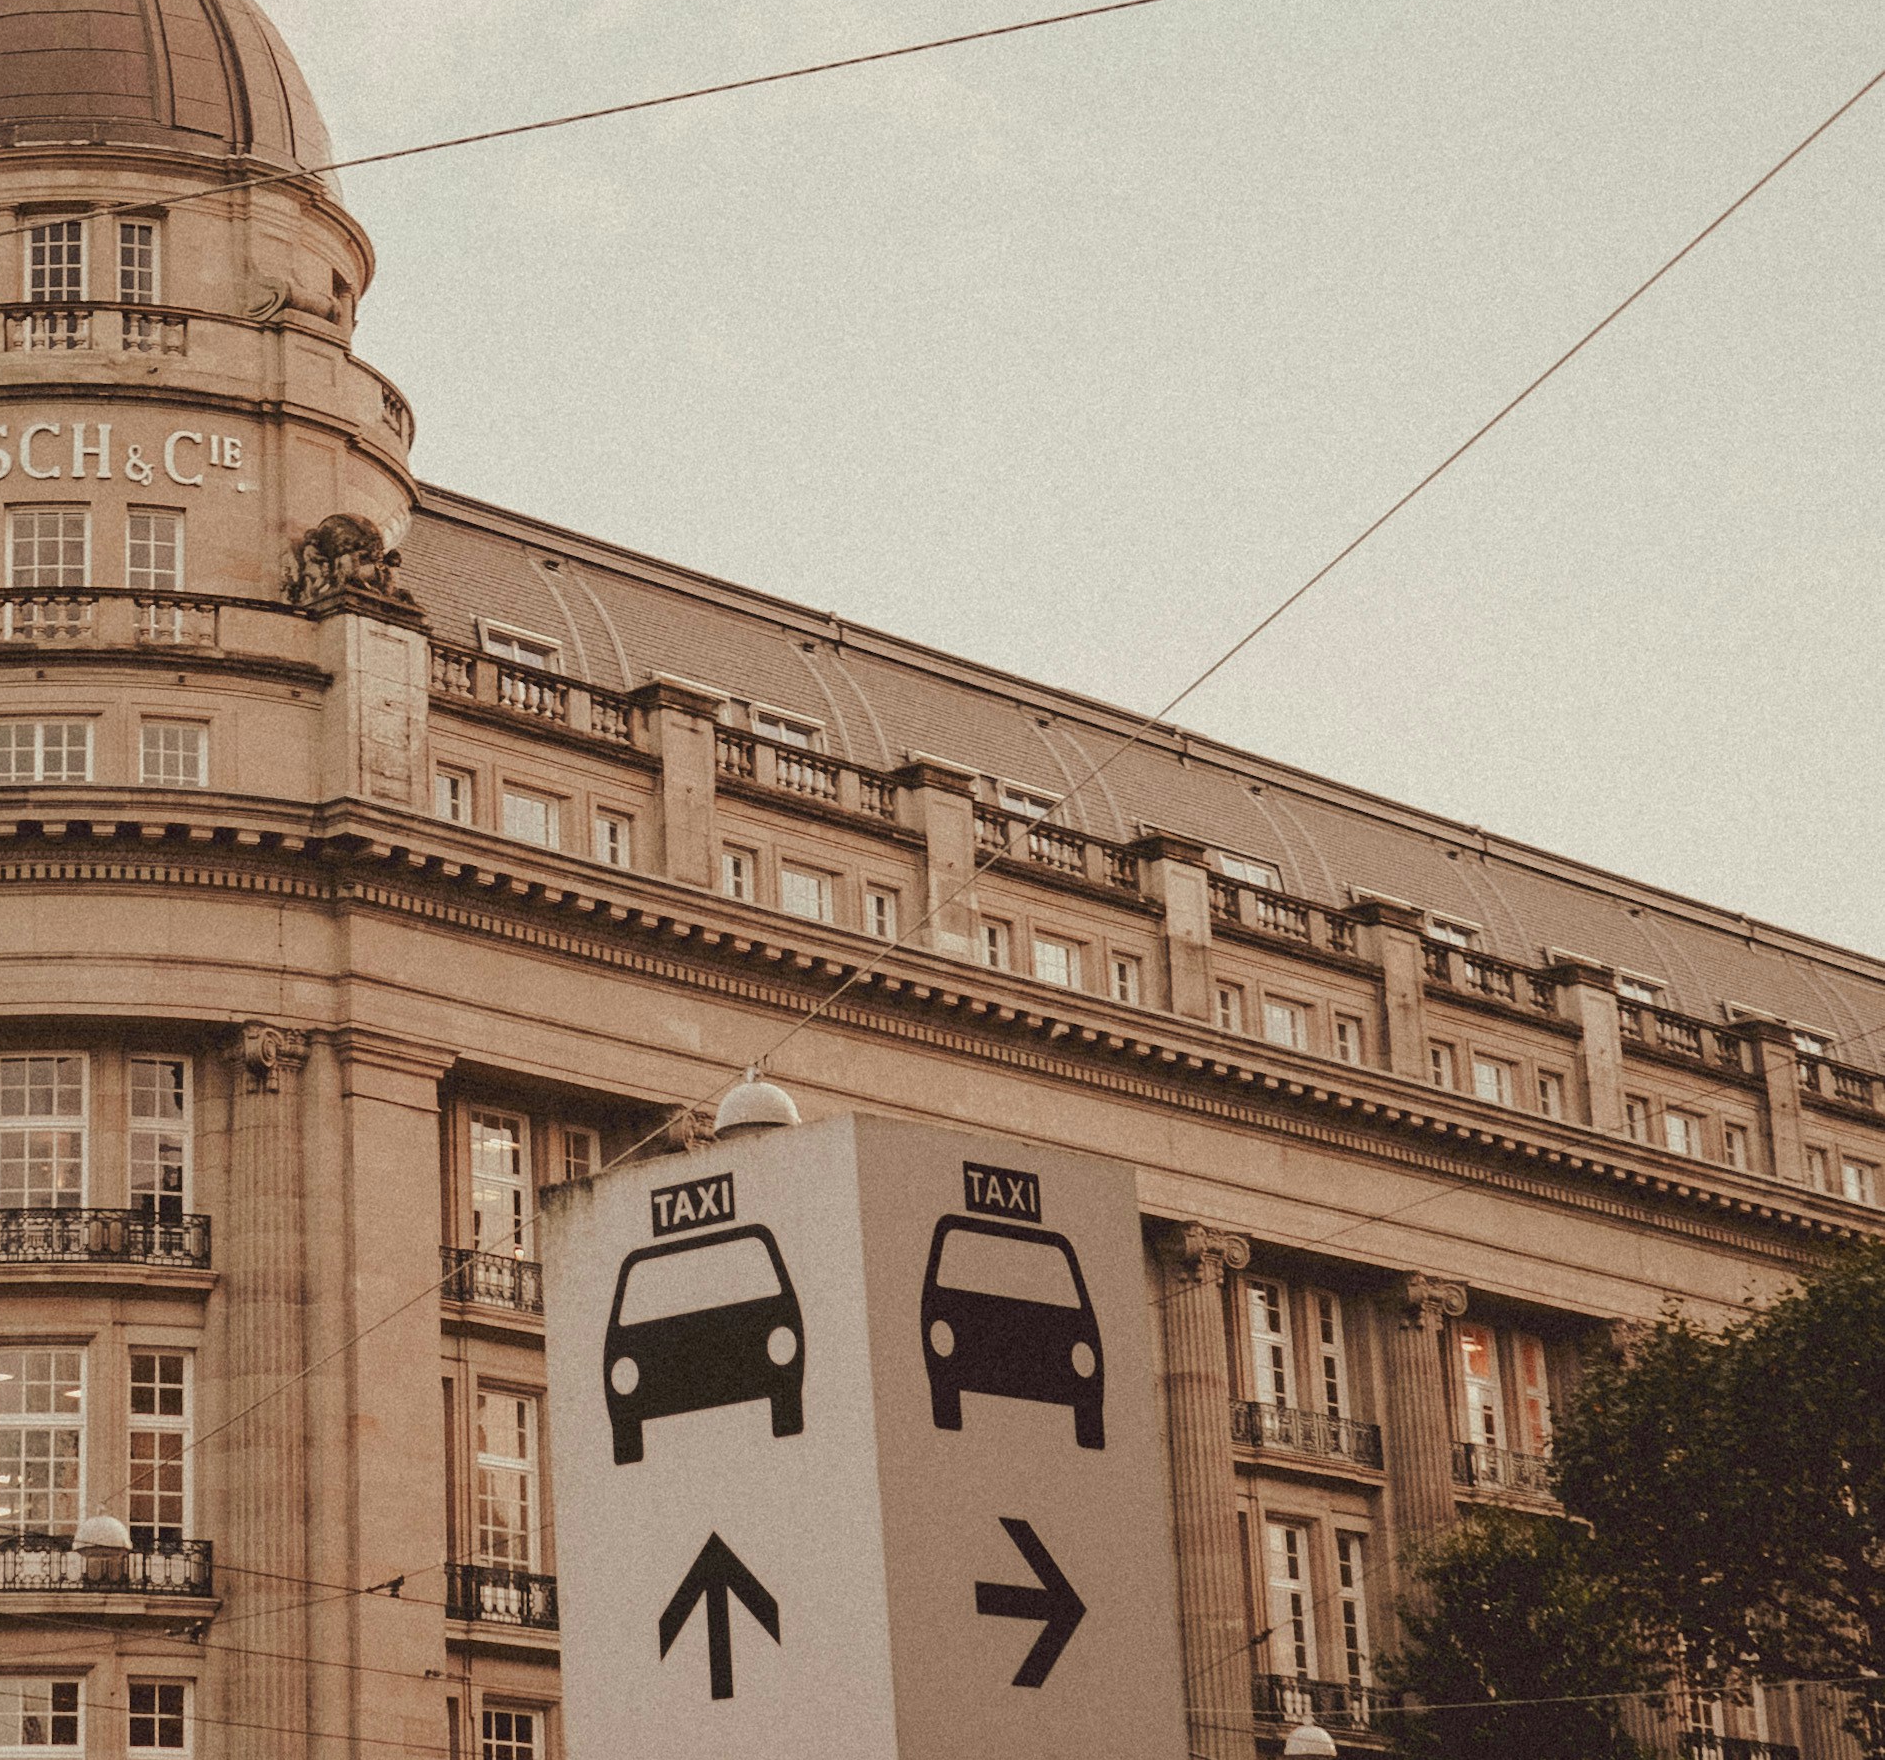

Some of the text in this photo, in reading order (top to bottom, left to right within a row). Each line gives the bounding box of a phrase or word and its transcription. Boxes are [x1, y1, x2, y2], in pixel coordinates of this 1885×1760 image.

[124, 444, 155, 487] &
[653, 1180, 731, 1228] TAXI
[968, 1170, 1037, 1214] TAXI
